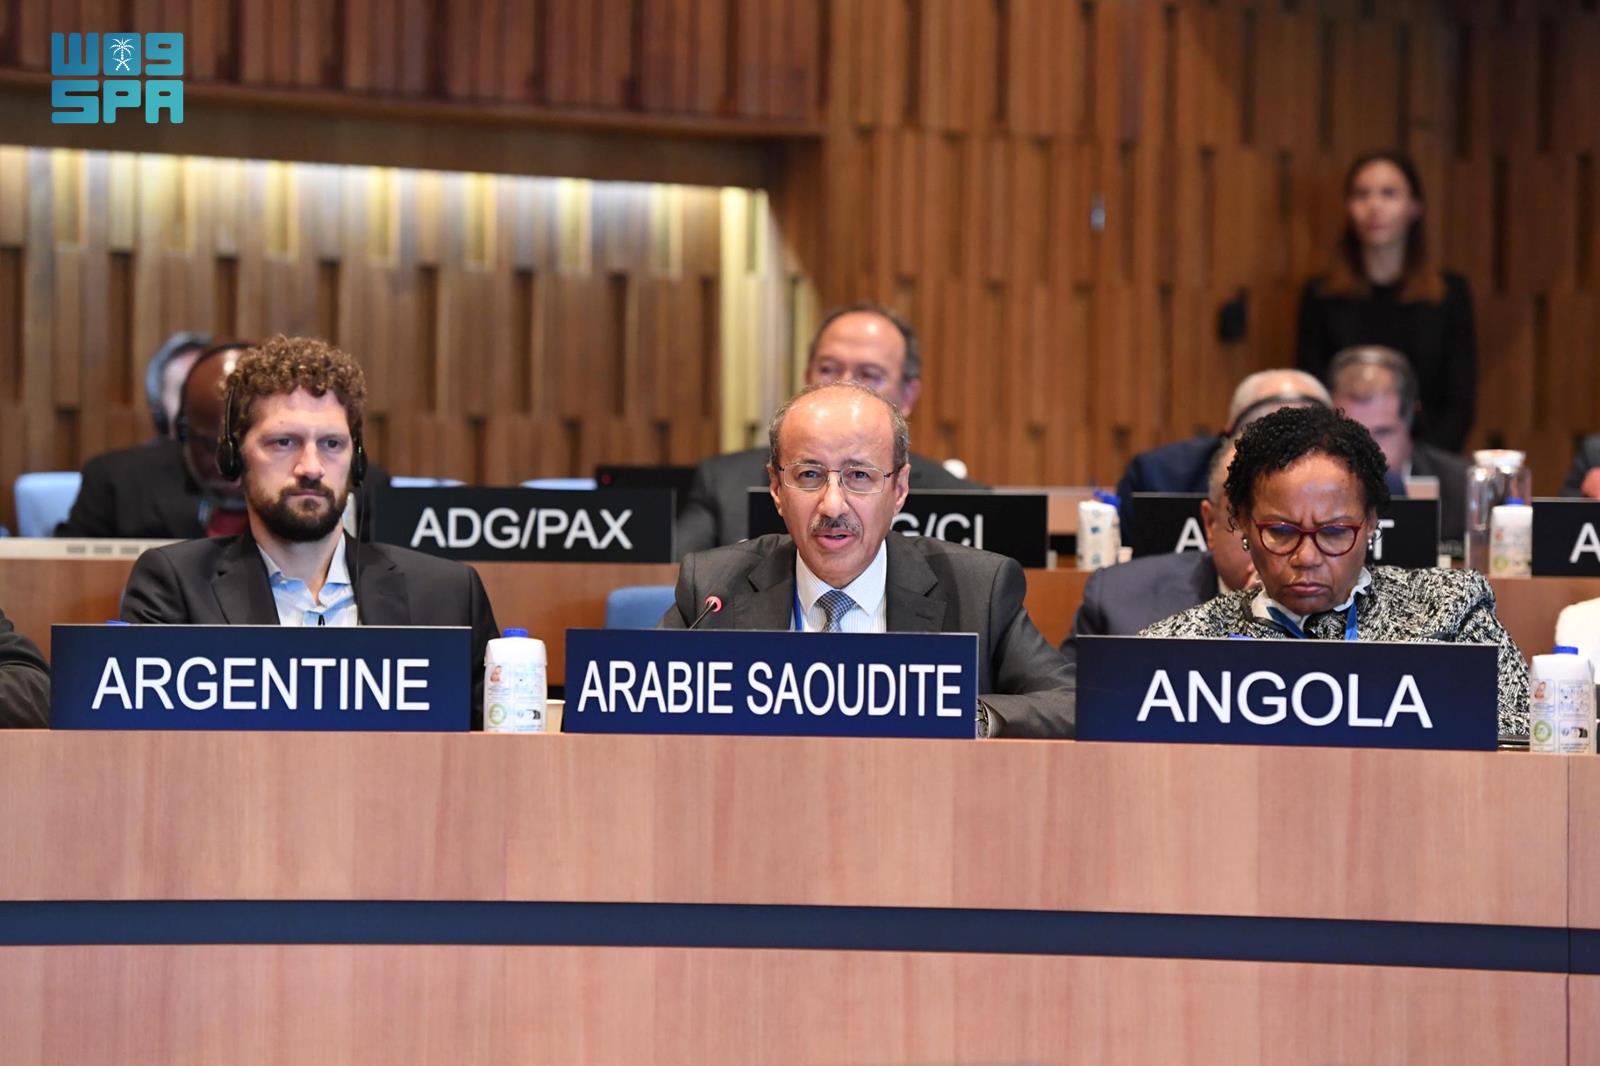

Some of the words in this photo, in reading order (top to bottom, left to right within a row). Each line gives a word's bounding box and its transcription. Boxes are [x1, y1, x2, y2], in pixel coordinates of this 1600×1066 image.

[410, 507, 633, 550] ADG/PAX
[91, 656, 431, 711] ARGENTINE
[577, 660, 734, 714] ARABIE
[746, 661, 963, 717] SAOUDITE
[1136, 669, 1433, 729] ANGOLA
